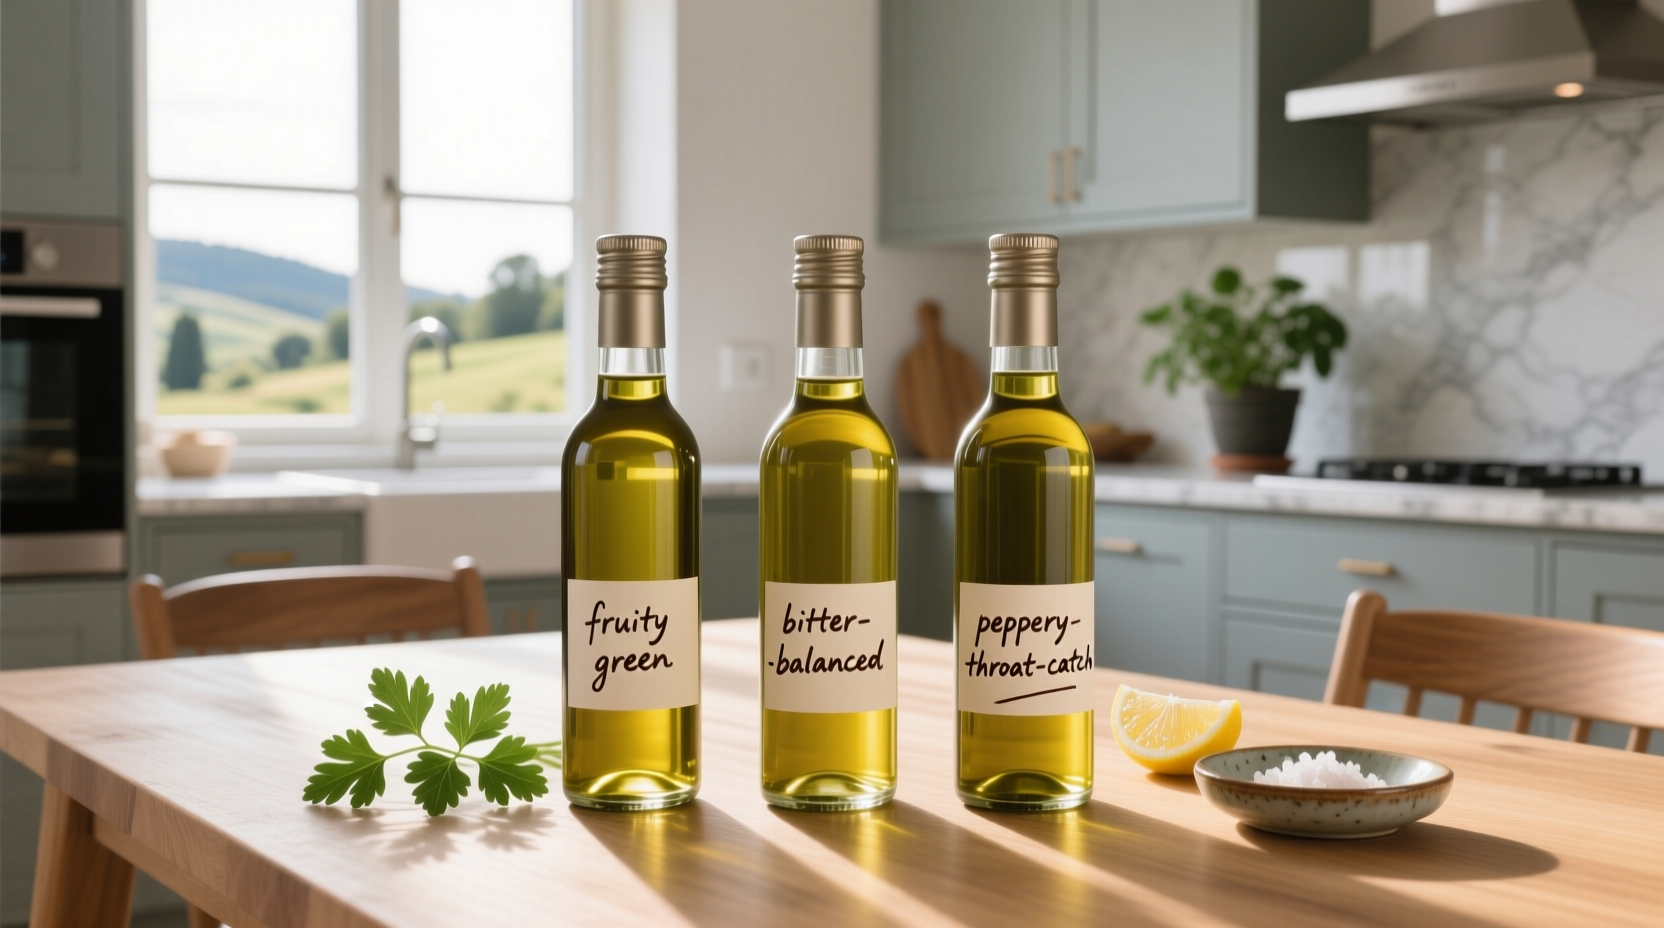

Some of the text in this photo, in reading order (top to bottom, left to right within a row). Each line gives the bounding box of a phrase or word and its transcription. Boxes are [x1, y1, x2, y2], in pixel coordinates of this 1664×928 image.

[584, 600, 669, 646] fruity
[782, 602, 871, 635] bitter-
[974, 614, 1081, 648] peppery-
[591, 652, 674, 693] green
[964, 644, 1093, 678] throat-catch
